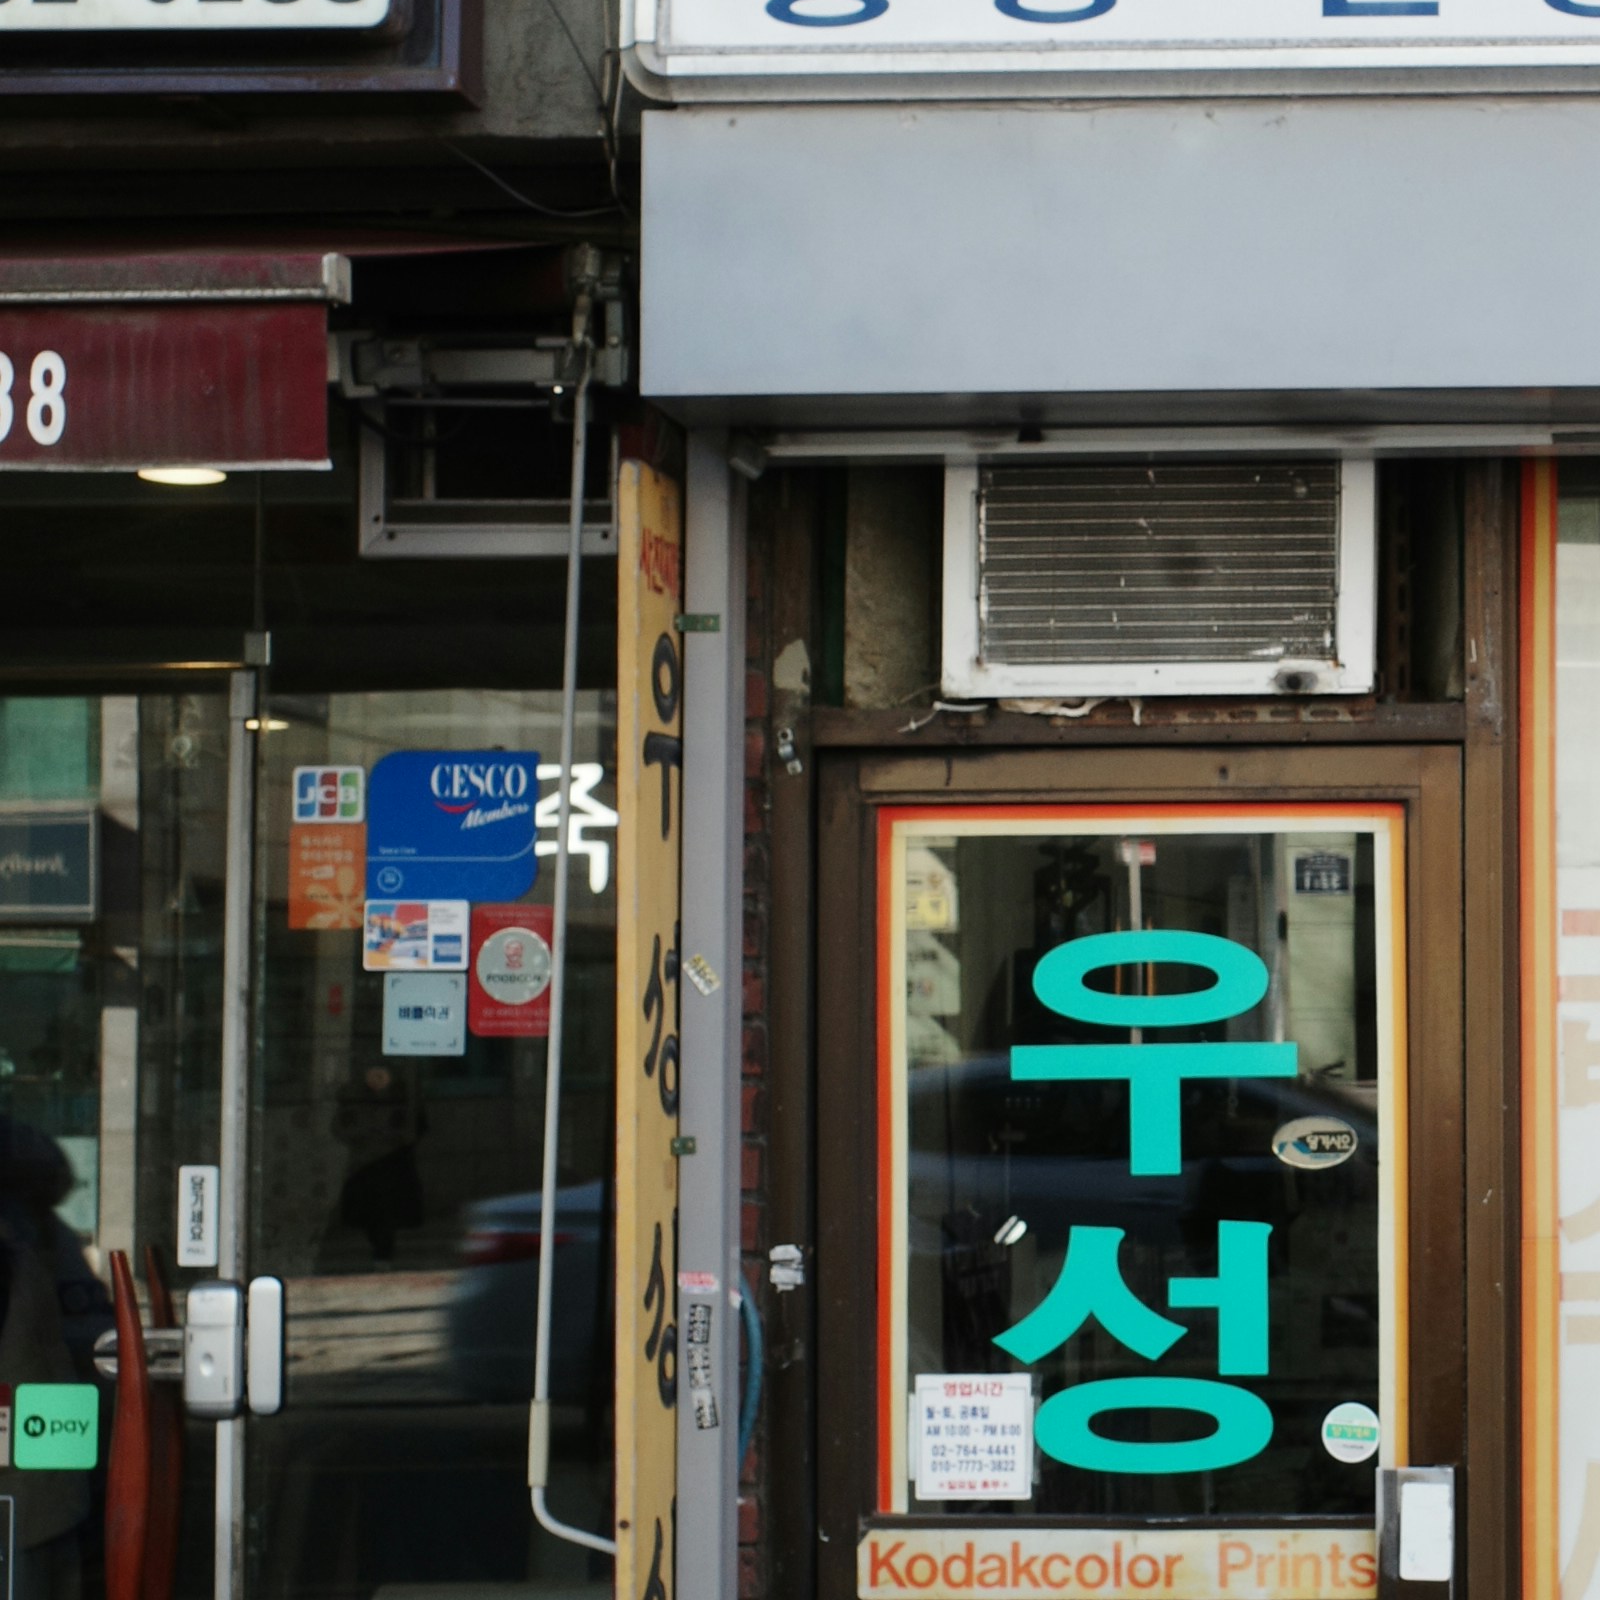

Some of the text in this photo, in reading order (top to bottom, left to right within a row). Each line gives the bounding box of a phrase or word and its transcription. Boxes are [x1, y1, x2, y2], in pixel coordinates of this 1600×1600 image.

[430, 763, 528, 799] CESCO
[297, 786, 360, 805] JCB
[459, 801, 530, 831] Members
[943, 1381, 1003, 1398] 영업시간
[51, 1418, 90, 1436] pay
[868, 1540, 1378, 1591] Kodakcolor Prints
